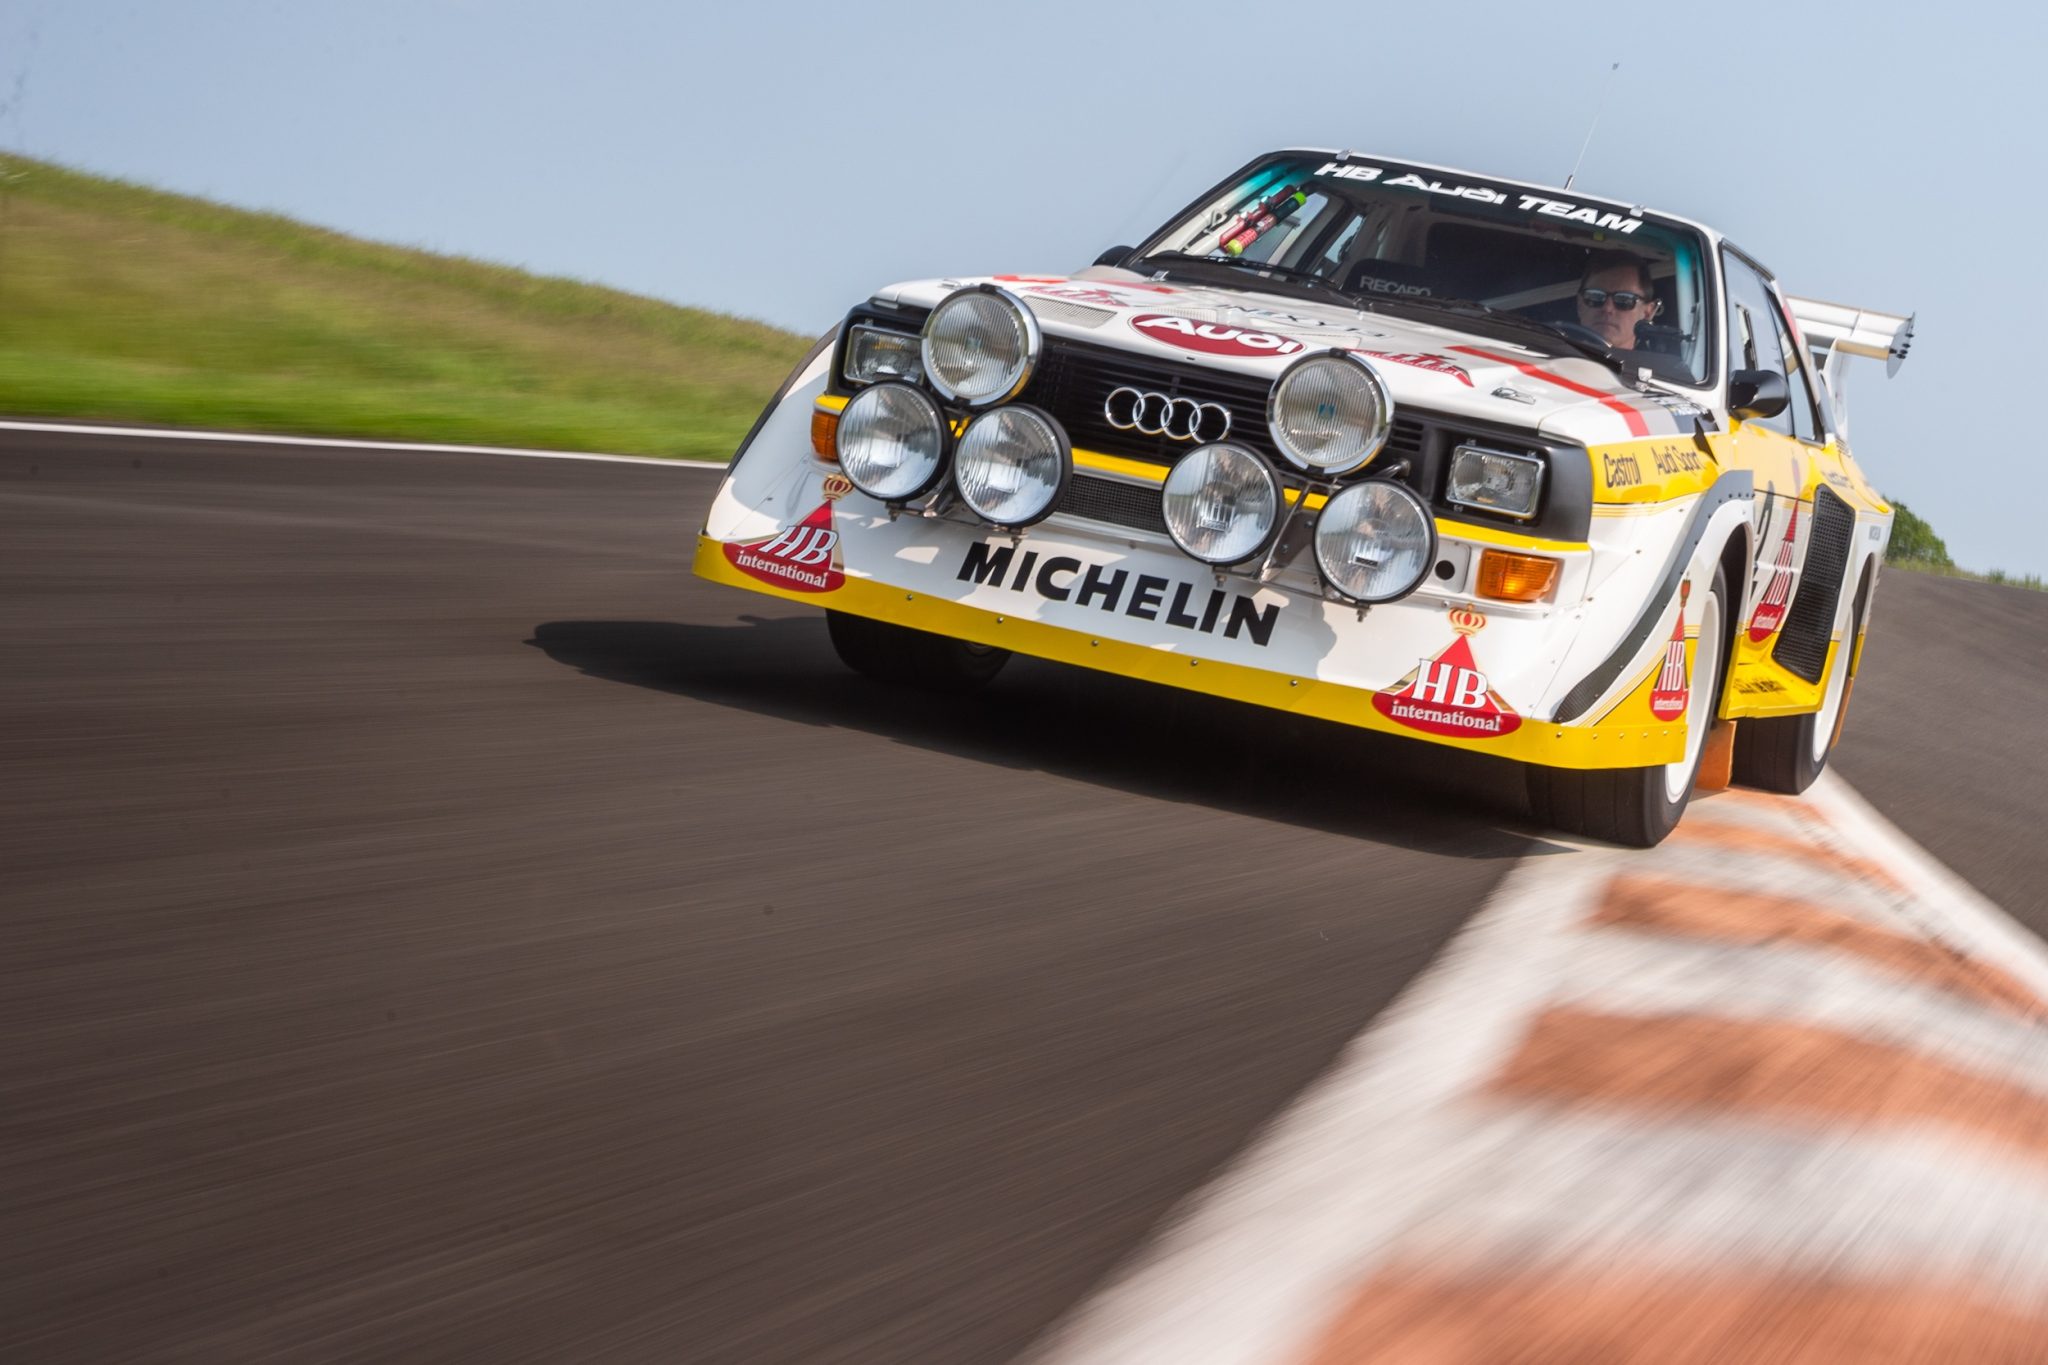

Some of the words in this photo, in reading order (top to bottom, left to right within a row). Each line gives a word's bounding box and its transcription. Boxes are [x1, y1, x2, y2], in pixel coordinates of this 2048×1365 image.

[1313, 162, 1384, 182] HB
[1517, 194, 1643, 234] TEAM
[1603, 452, 1642, 488] Castrol
[1650, 445, 1681, 475] Audi
[757, 525, 839, 565] HB
[736, 550, 829, 588] international
[956, 541, 1281, 647] MICHELIN
[1411, 658, 1489, 709] HB
[1661, 640, 1686, 692] HB
[1390, 700, 1502, 732] international
